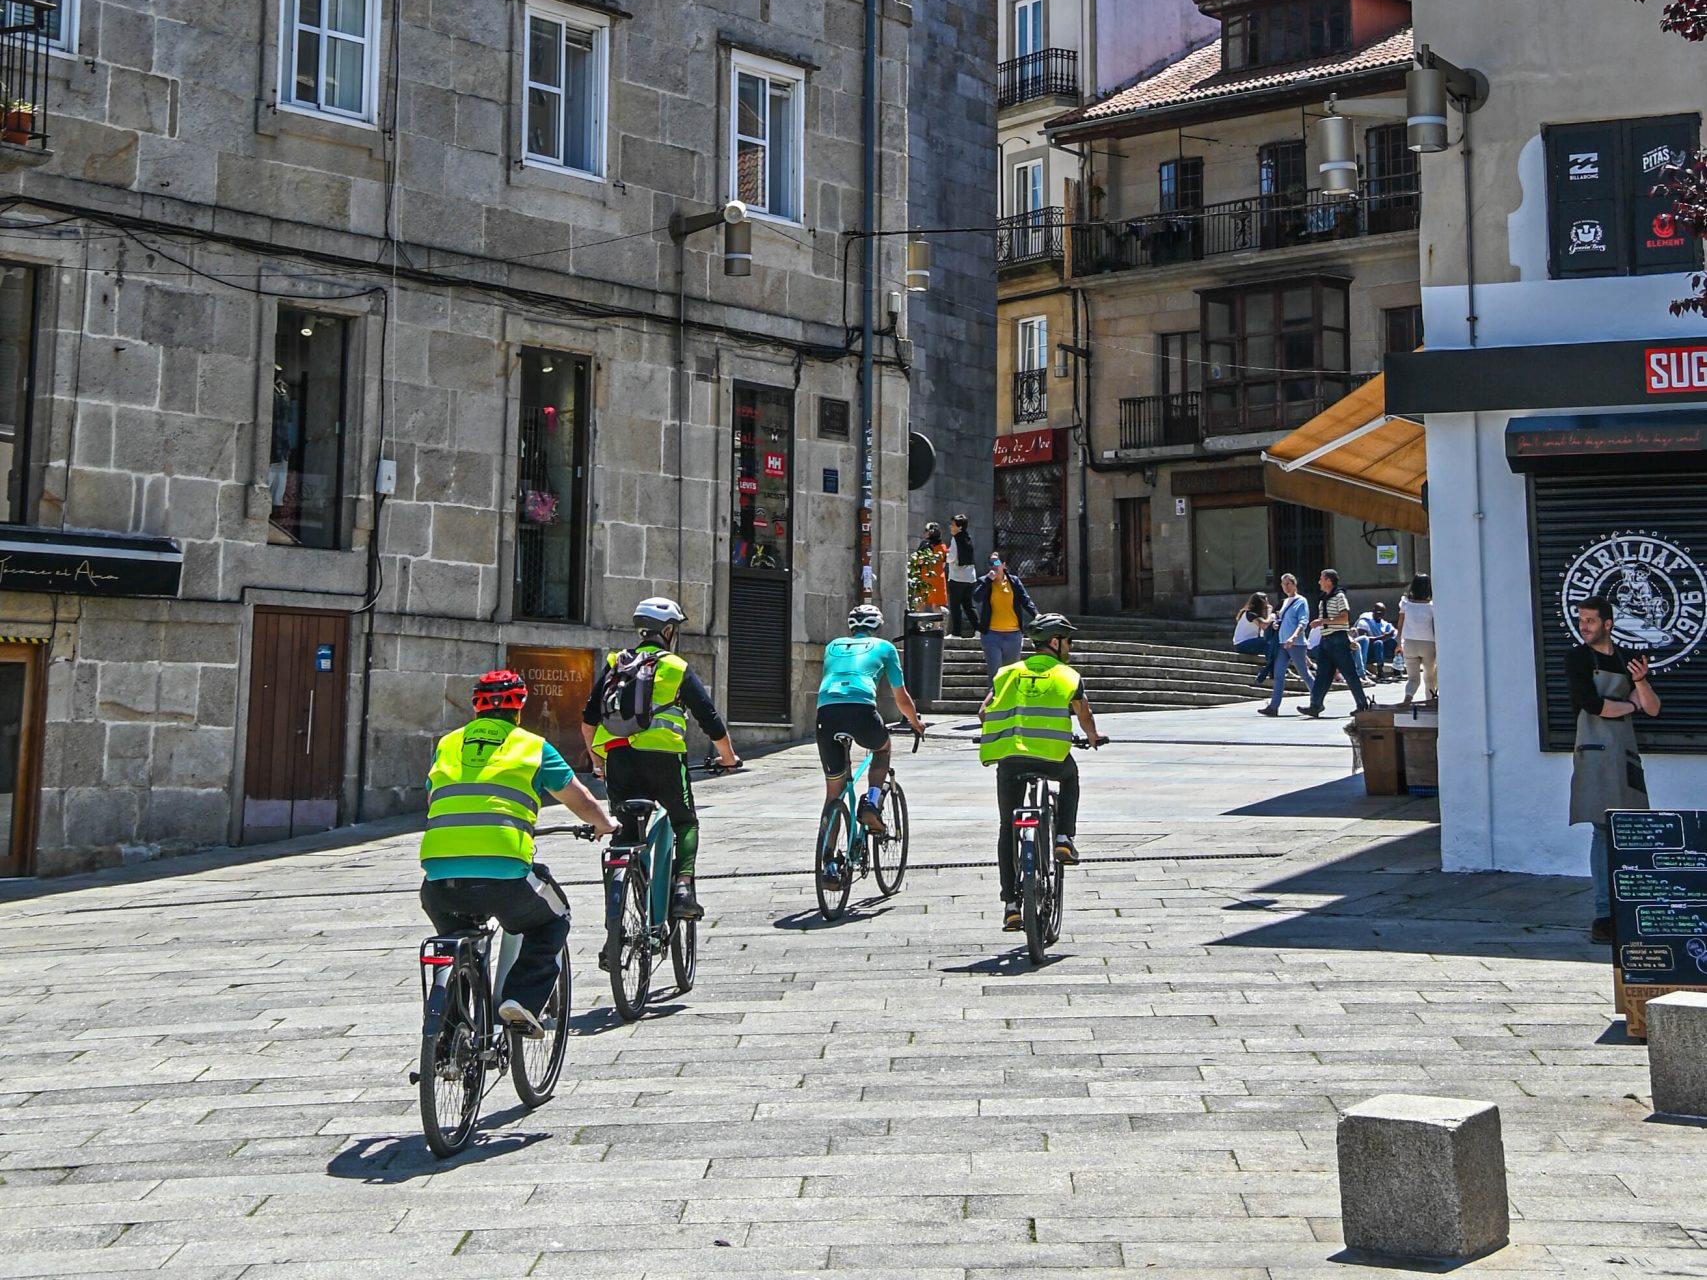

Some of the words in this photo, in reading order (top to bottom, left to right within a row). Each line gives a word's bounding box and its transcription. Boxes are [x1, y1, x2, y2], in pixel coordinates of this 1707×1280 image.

[1642, 148, 1670, 170] PITAS
[1569, 173, 1599, 181] BILLABONG
[1646, 238, 1685, 248] ELEMENT
[1621, 542, 1689, 574] LOAF
[1672, 590, 1704, 644] 1976
[528, 668, 583, 682] COLEGIATA
[533, 684, 563, 697] STORE
